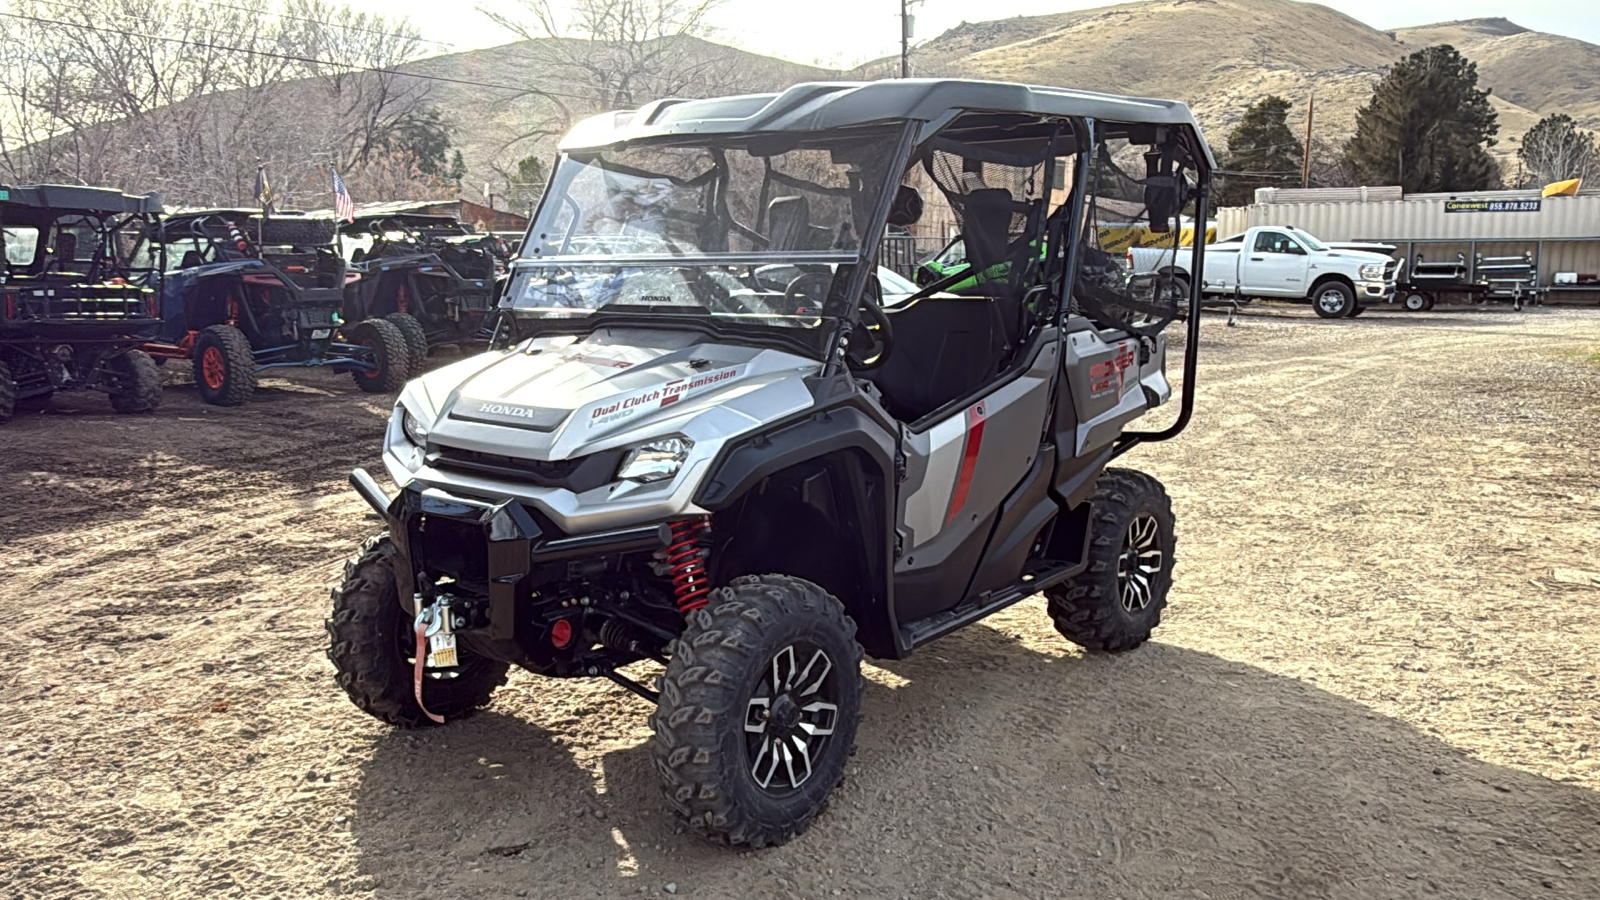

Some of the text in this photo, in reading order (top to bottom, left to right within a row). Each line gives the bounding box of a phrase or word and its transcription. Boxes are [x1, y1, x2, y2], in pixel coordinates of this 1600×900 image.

[1489, 202, 1538, 210] 855.878.5233
[591, 369, 737, 419] Dual Clutch Transmission
[478, 403, 534, 418] HONDA
